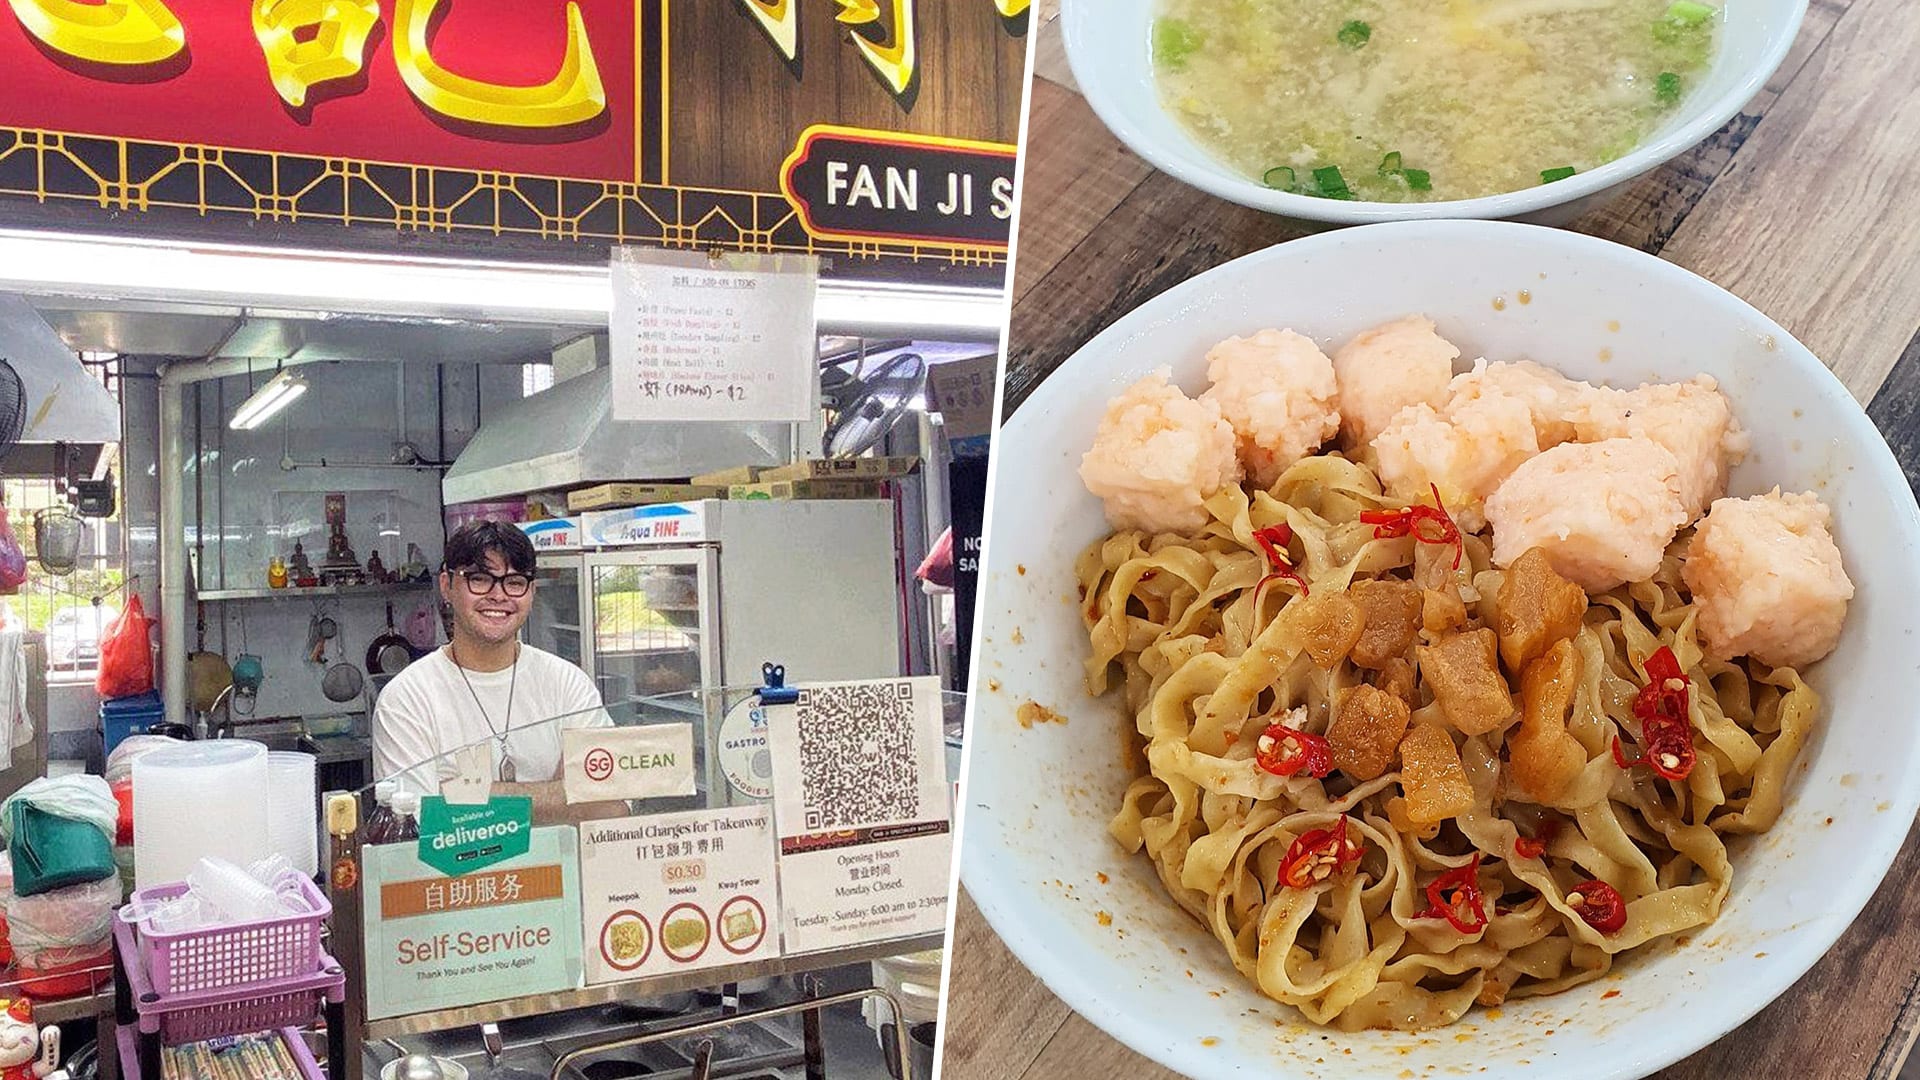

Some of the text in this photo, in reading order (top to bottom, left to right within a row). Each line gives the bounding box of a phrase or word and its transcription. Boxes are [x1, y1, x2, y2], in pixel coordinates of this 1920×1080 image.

[826, 161, 918, 211] FAN
[937, 173, 972, 216] JI
[620, 520, 680, 541] Aqua FINE
[589, 753, 675, 772] SG CLEAN
[432, 820, 519, 850] deliveroo
[586, 815, 769, 845] Additional Charges for Takeaway
[636, 836, 725, 861] 打包额外费用
[837, 849, 900, 866] Opening Hours
[849, 863, 892, 881] 营业时间
[424, 875, 525, 910] 自助服务
[835, 883, 870, 897] Monday
[793, 911, 830, 928] Tuesday
[871, 903, 890, 916] 6:00
[891, 902, 906, 912] am
[907, 900, 917, 910] to
[397, 925, 552, 966] Self-Service
[417, 966, 442, 980] Thank
[444, 964, 459, 977] You
[460, 962, 476, 974] and
[477, 960, 494, 973] See
[495, 959, 510, 971] You
